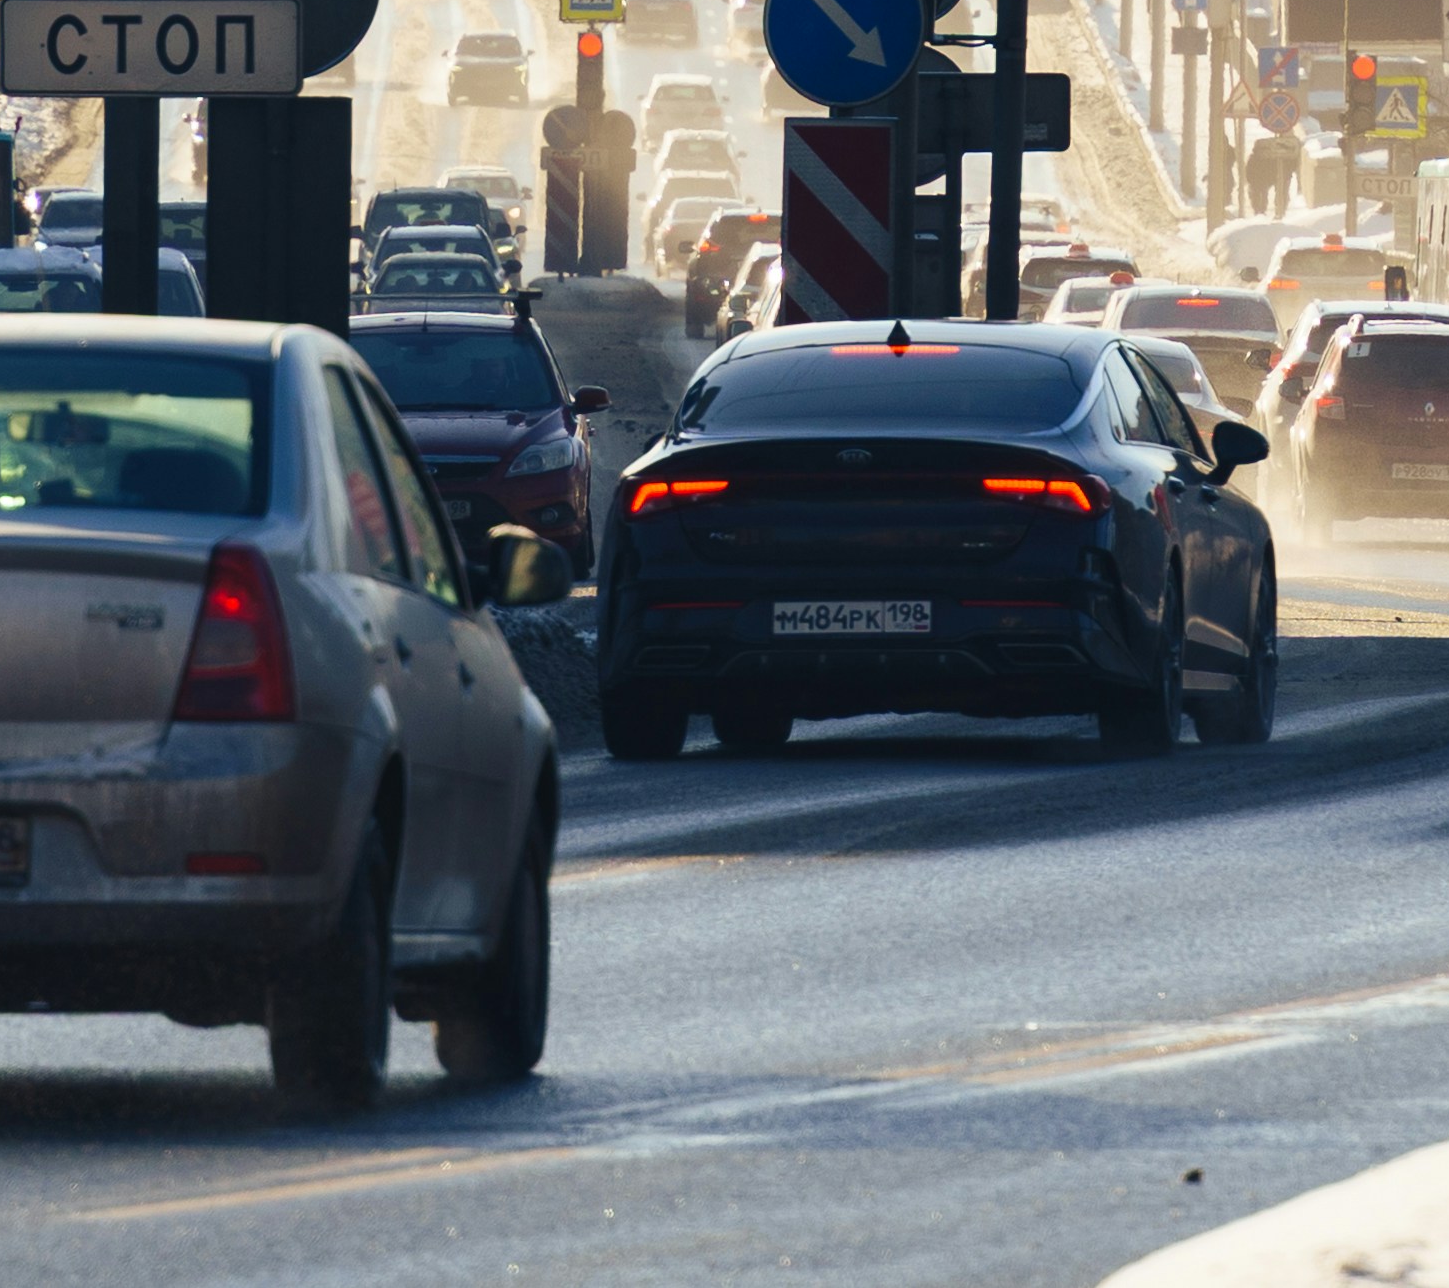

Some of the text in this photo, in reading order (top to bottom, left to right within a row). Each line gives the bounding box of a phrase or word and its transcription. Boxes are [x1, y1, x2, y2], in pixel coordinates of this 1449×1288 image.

[47, 14, 255, 75] СТОП
[1362, 178, 1411, 194] СТОП
[887, 603, 925, 623] 198
